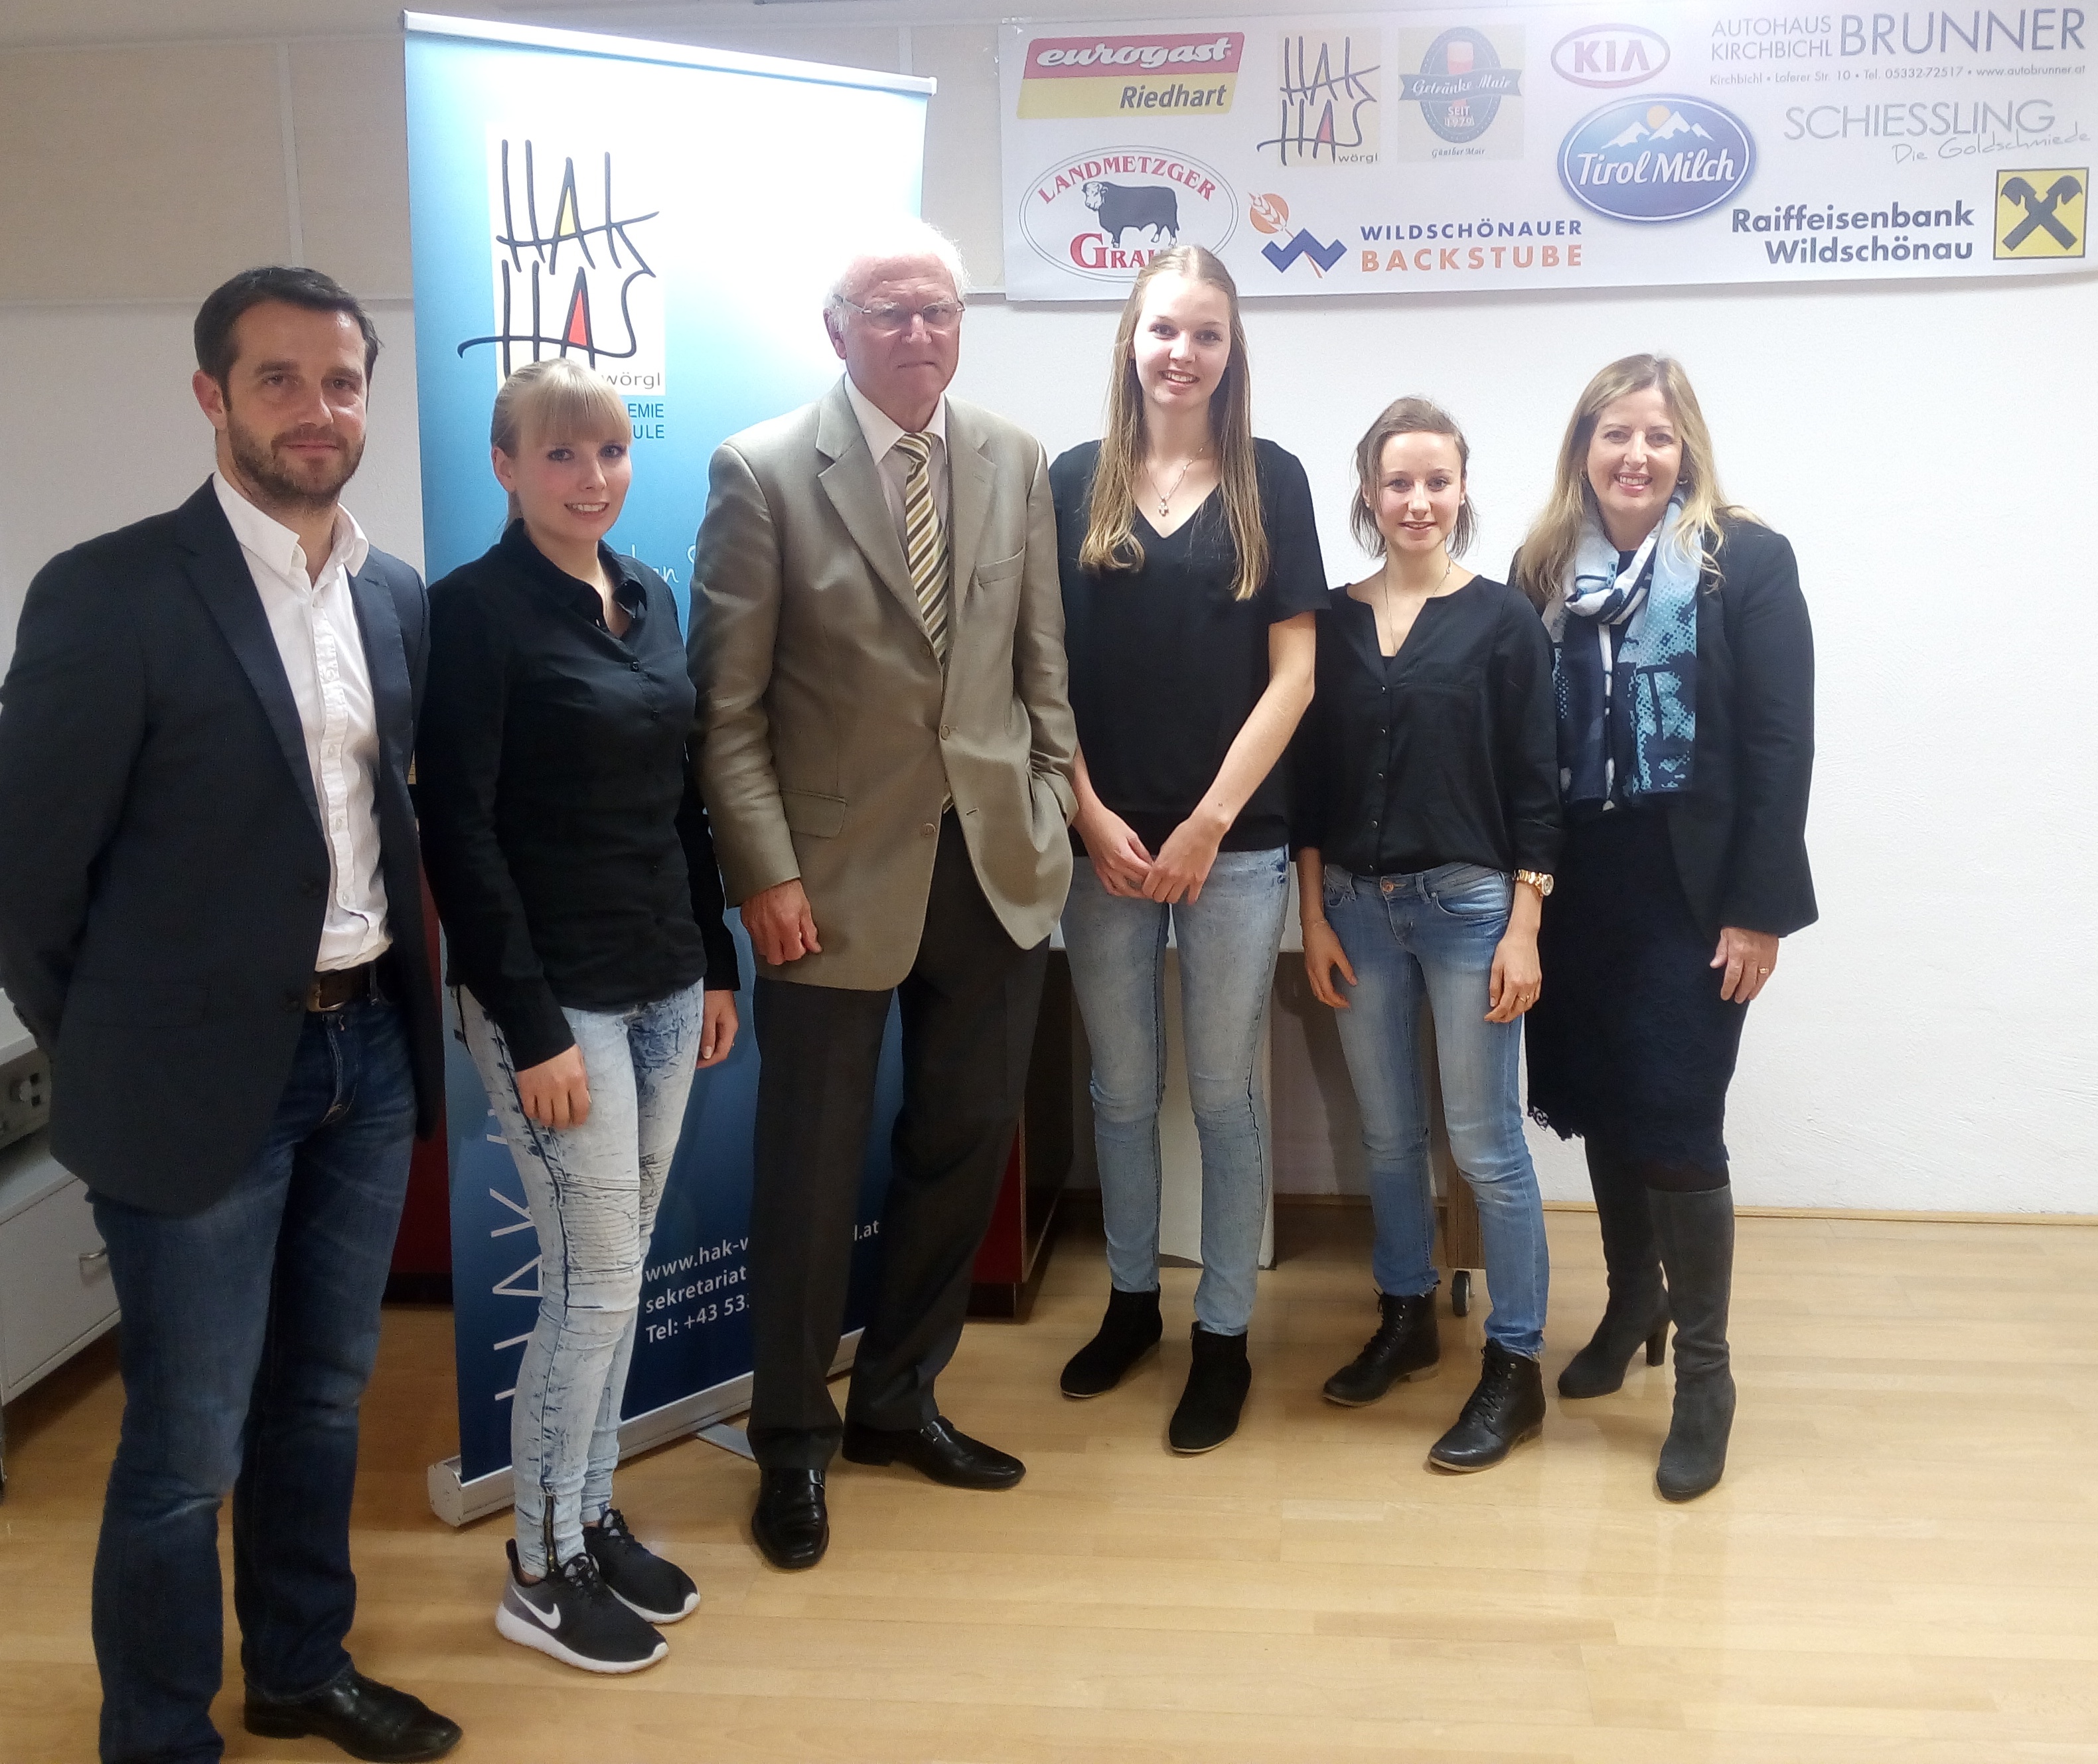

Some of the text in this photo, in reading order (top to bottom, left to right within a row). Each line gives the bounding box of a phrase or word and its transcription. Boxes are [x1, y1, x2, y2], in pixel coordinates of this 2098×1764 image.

[1711, 15, 1832, 37] AUTOHAUS
[1840, 7, 2086, 56] BRUNNER
[1036, 37, 1232, 69] eurogast
[1573, 39, 1651, 73] KIA
[1711, 38, 1833, 62] KIRCHBICHL
[1710, 72, 1763, 86] Kirchbichl
[1119, 84, 1227, 110] Riedhart
[1448, 106, 1471, 116] SEIT
[1783, 99, 2056, 141] SCHIESSLING
[1892, 121, 2091, 164] Die Goldschmiede
[1338, 153, 1379, 165] wörgl
[1577, 147, 1736, 186] Tirol Milch
[1037, 155, 1217, 204] LANDMETZGER
[1359, 218, 1582, 242] WILDSCHÖNAUER
[1732, 200, 1975, 233] Raiffeisenbank
[1070, 232, 1156, 269] GRA
[1361, 244, 1582, 273] BACKSTUBE
[1764, 235, 1974, 264] Wildschönau
[601, 372, 661, 390] wörgl
[627, 403, 665, 419] EMIE
[633, 424, 665, 439] ULE
[645, 1265, 747, 1315] sekretariat
[645, 1292, 750, 1344] Tel: +43 53
